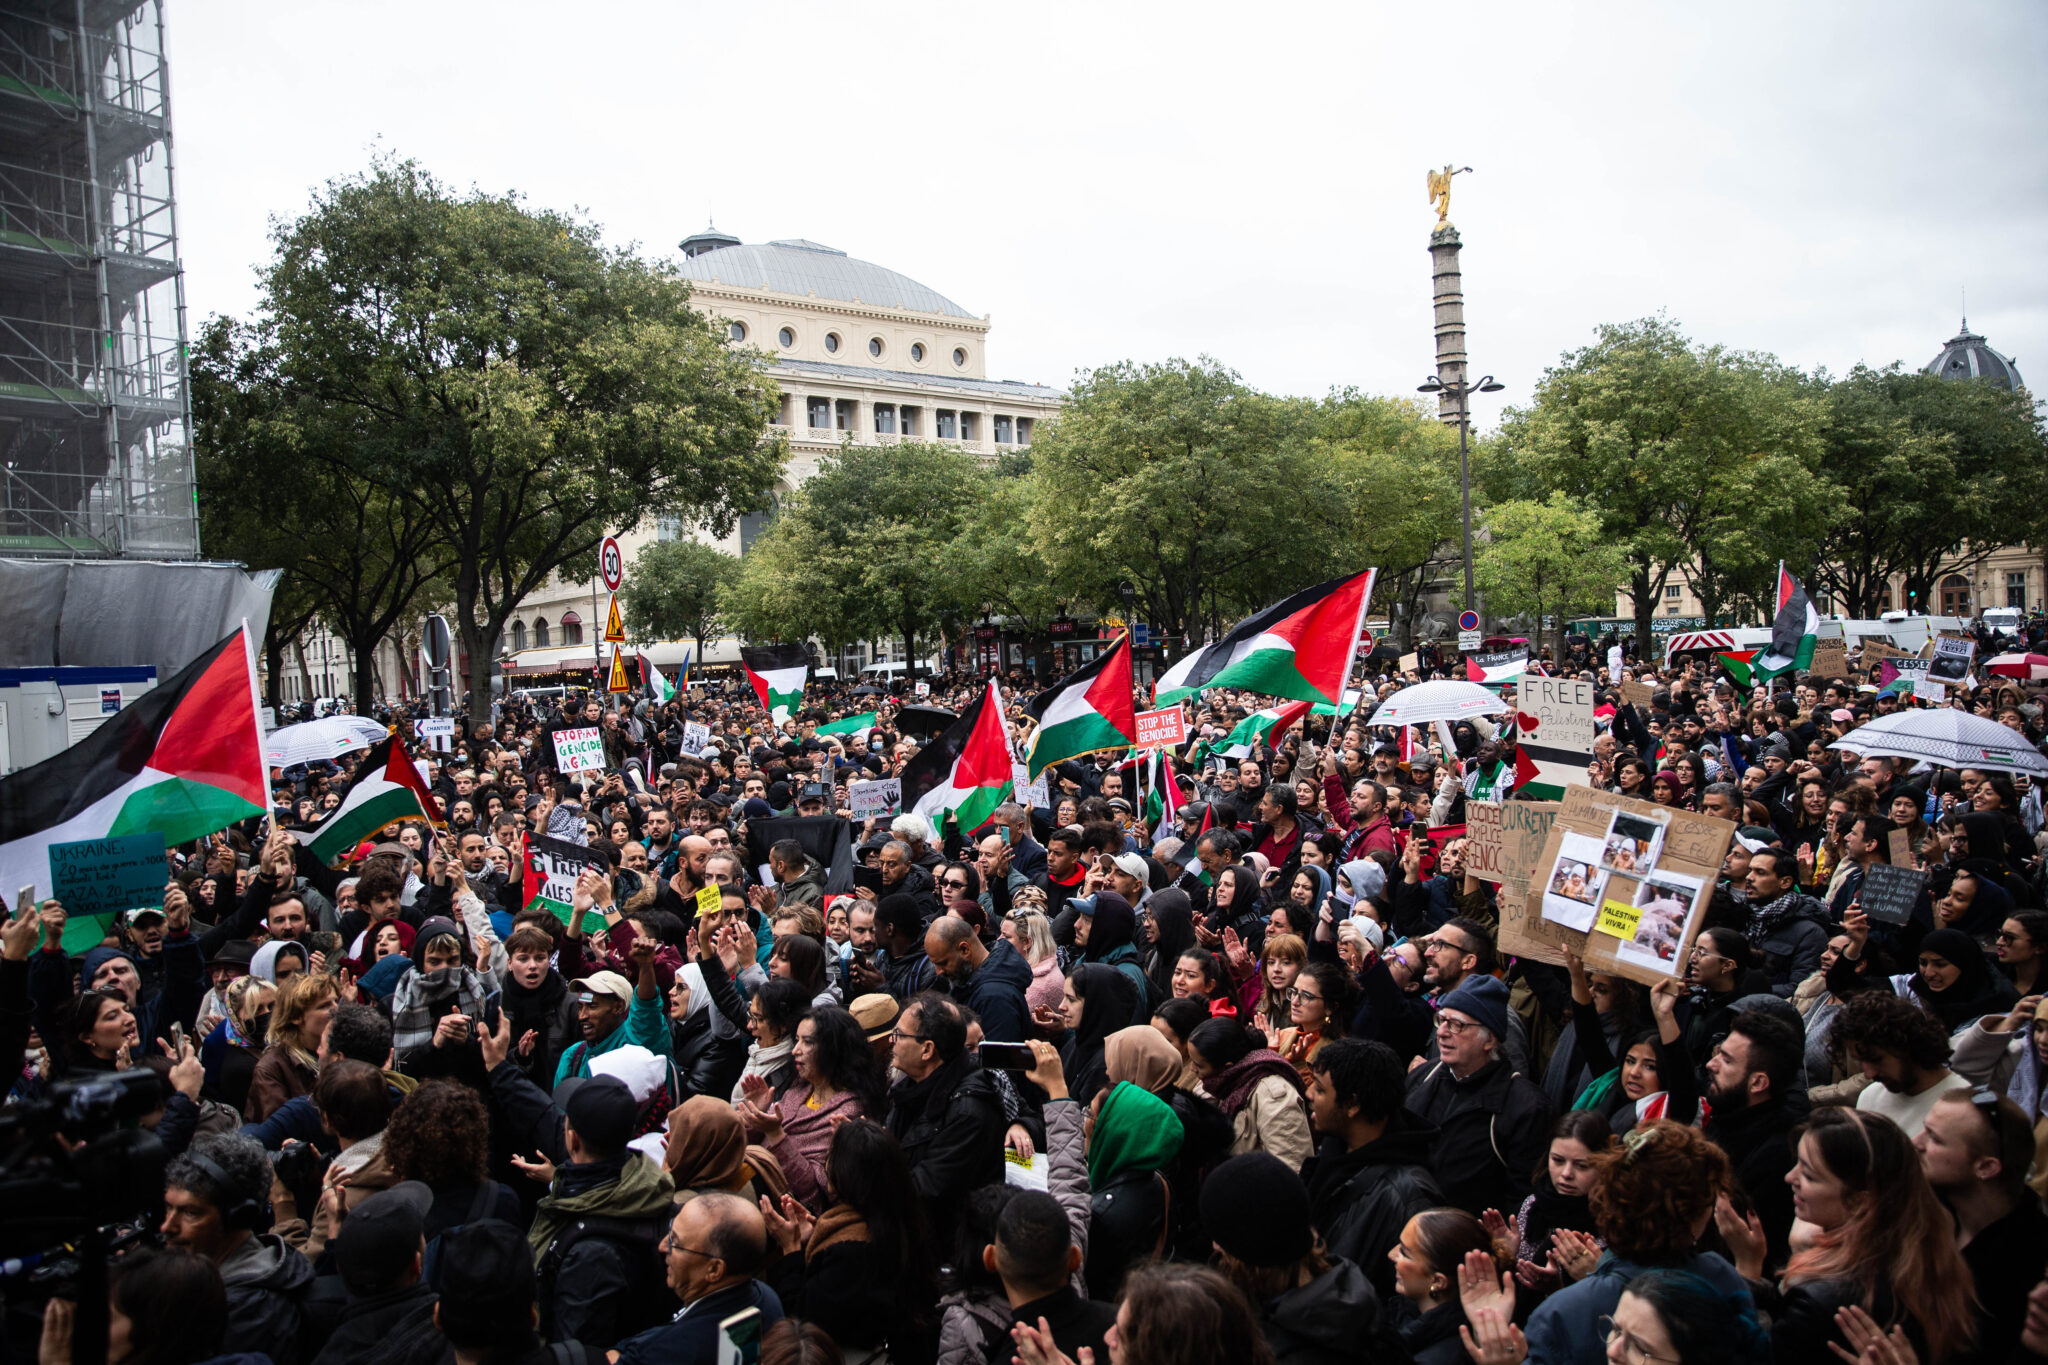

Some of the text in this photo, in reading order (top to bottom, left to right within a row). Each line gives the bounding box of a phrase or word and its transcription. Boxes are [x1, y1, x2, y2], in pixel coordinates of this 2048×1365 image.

[606, 552, 618, 576] 30
[1525, 680, 1590, 706] FREE
[1460, 700, 1486, 708] PALESTINE
[1138, 713, 1177, 731] STOP THE
[553, 727, 598, 744] STOP AU
[1139, 726, 1179, 743] GENOCIDE
[58, 862, 77, 877] 20
[1603, 906, 1640, 923] PALESTINE
[1873, 901, 1904, 915] HUMAN
[1605, 917, 1626, 930] VIVRA
